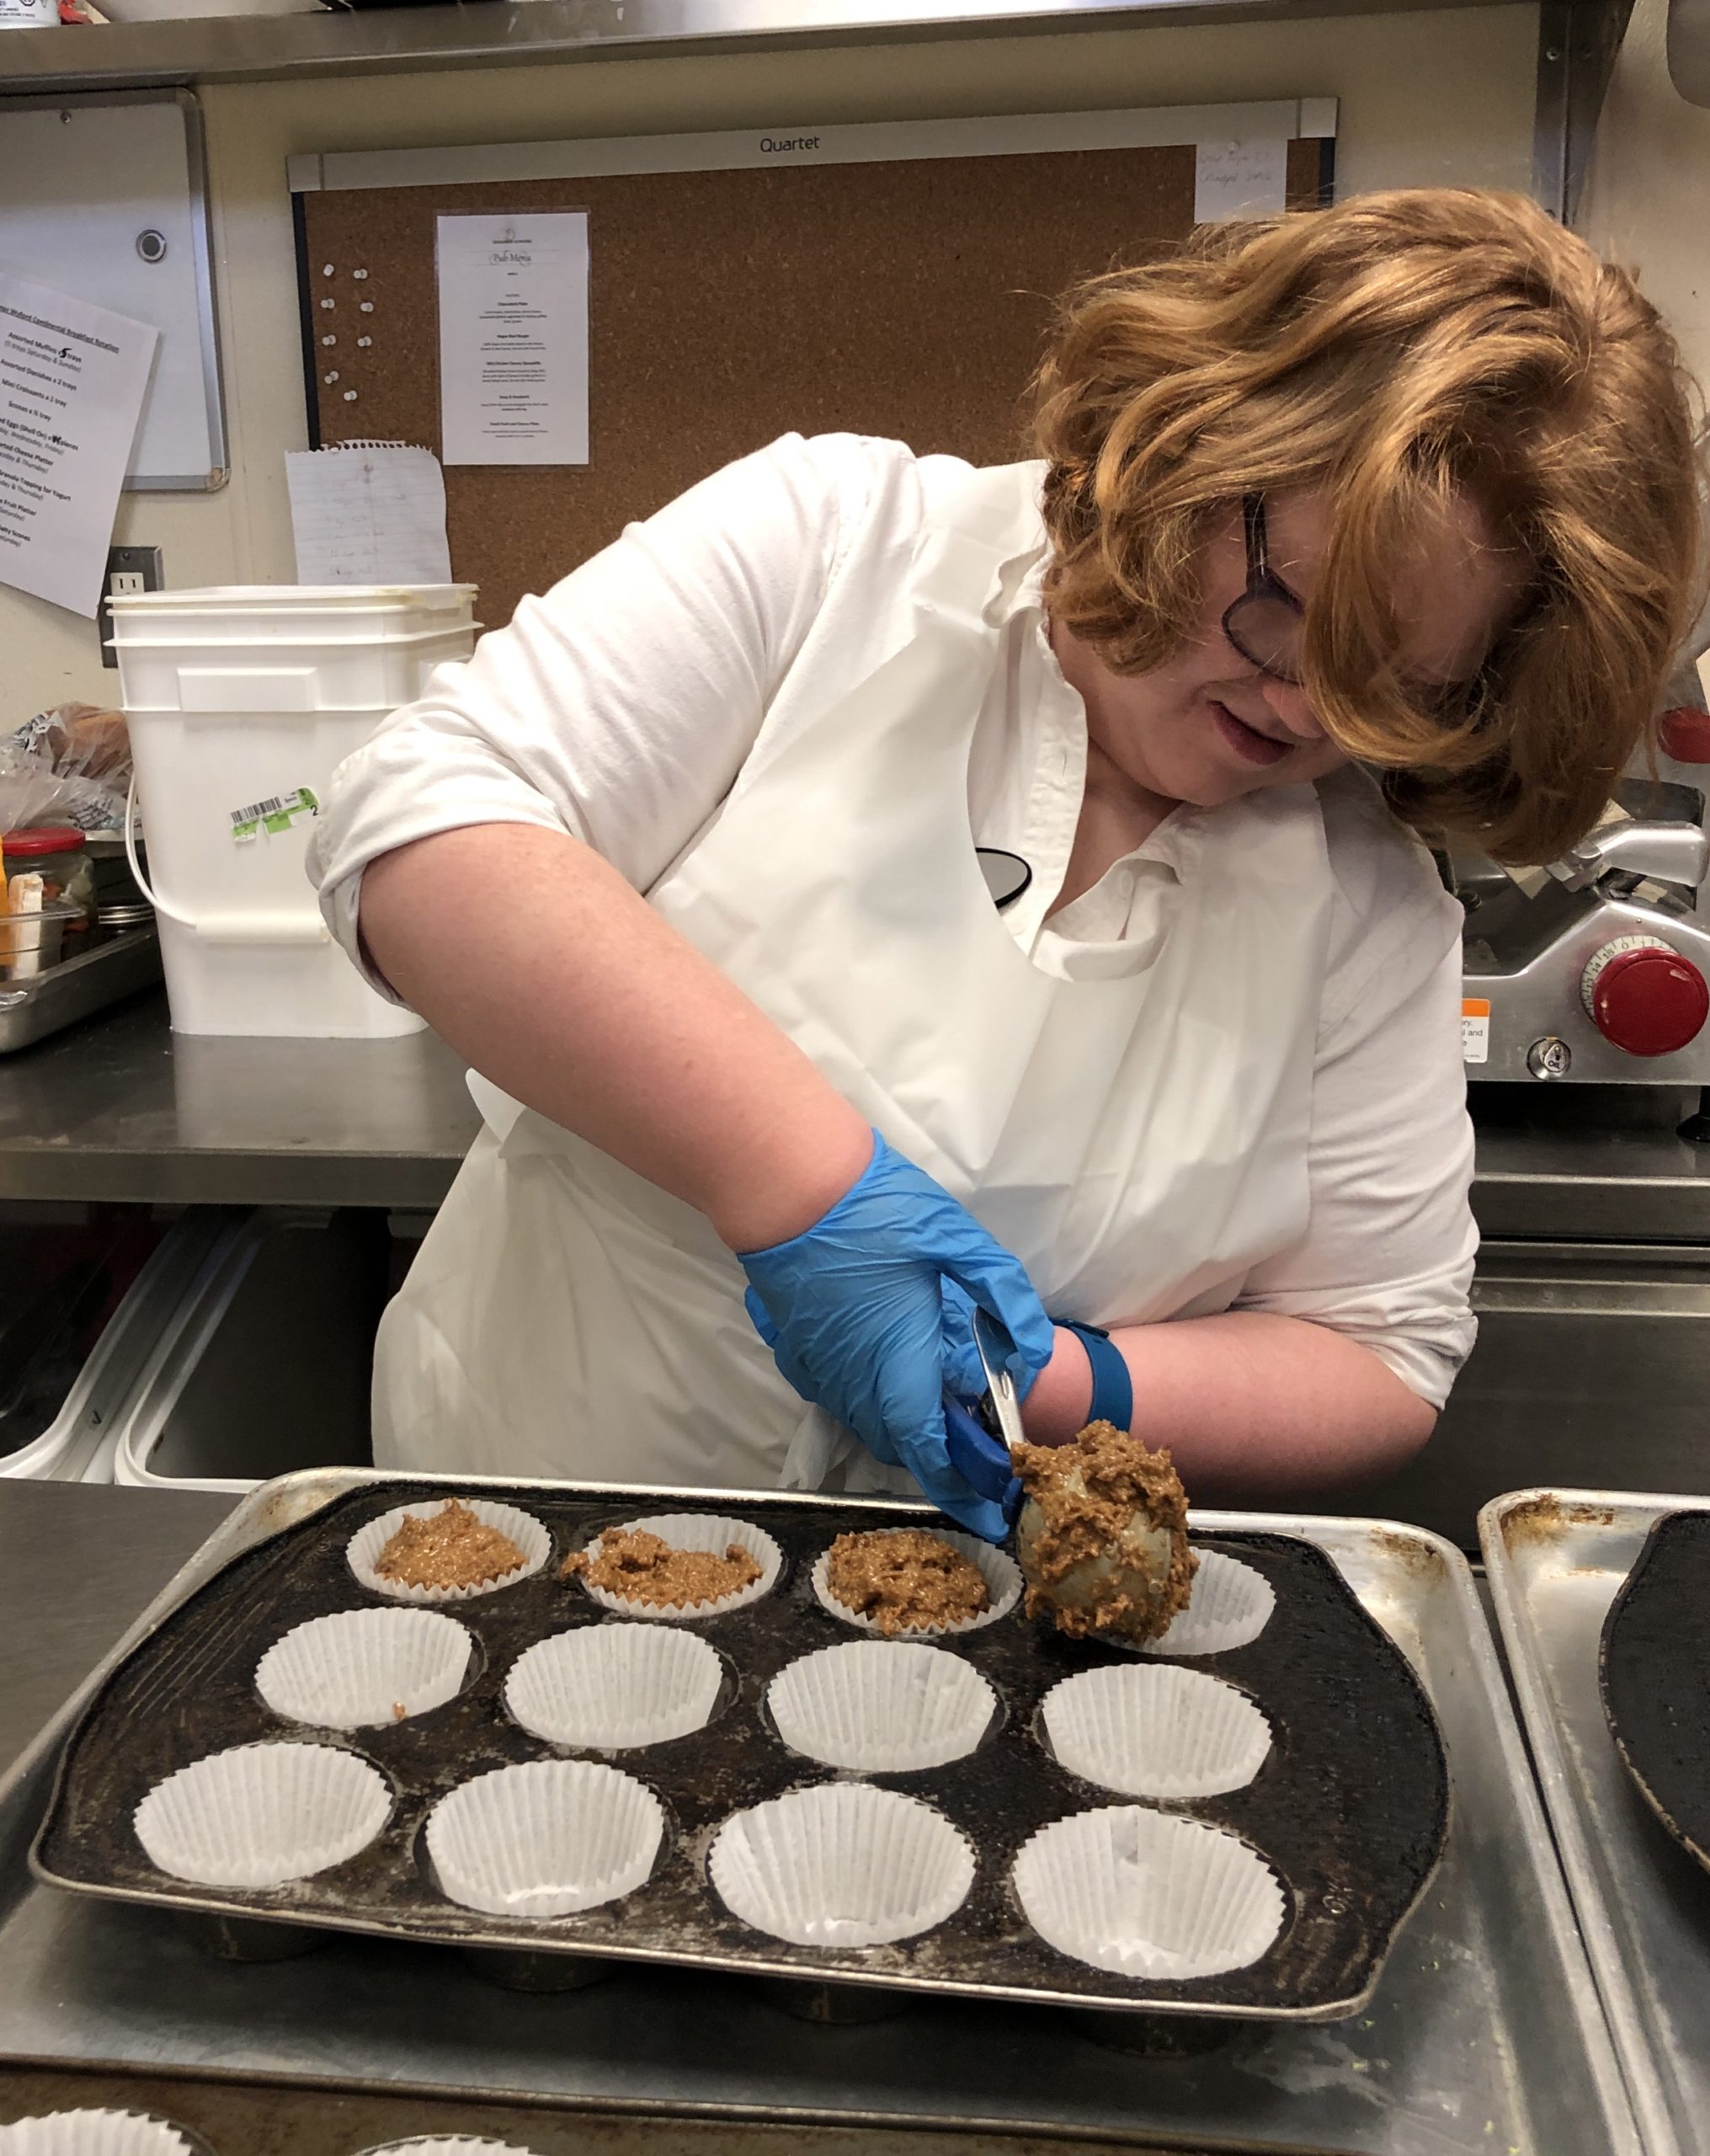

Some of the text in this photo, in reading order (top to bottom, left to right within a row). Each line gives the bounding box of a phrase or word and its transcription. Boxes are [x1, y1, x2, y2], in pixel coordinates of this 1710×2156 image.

[760, 136, 821, 152] Quartet
[8, 332, 35, 346] Assorted
[35, 340, 57, 355] Muffins
[1, 359, 26, 372] Assorted
[62, 381, 77, 391] trays
[55, 398, 67, 408] tray
[40, 412, 51, 421] tray
[35, 455, 54, 466] Platter
[1603, 948, 1615, 959] 15
[1548, 1060, 1561, 1070] OIL
